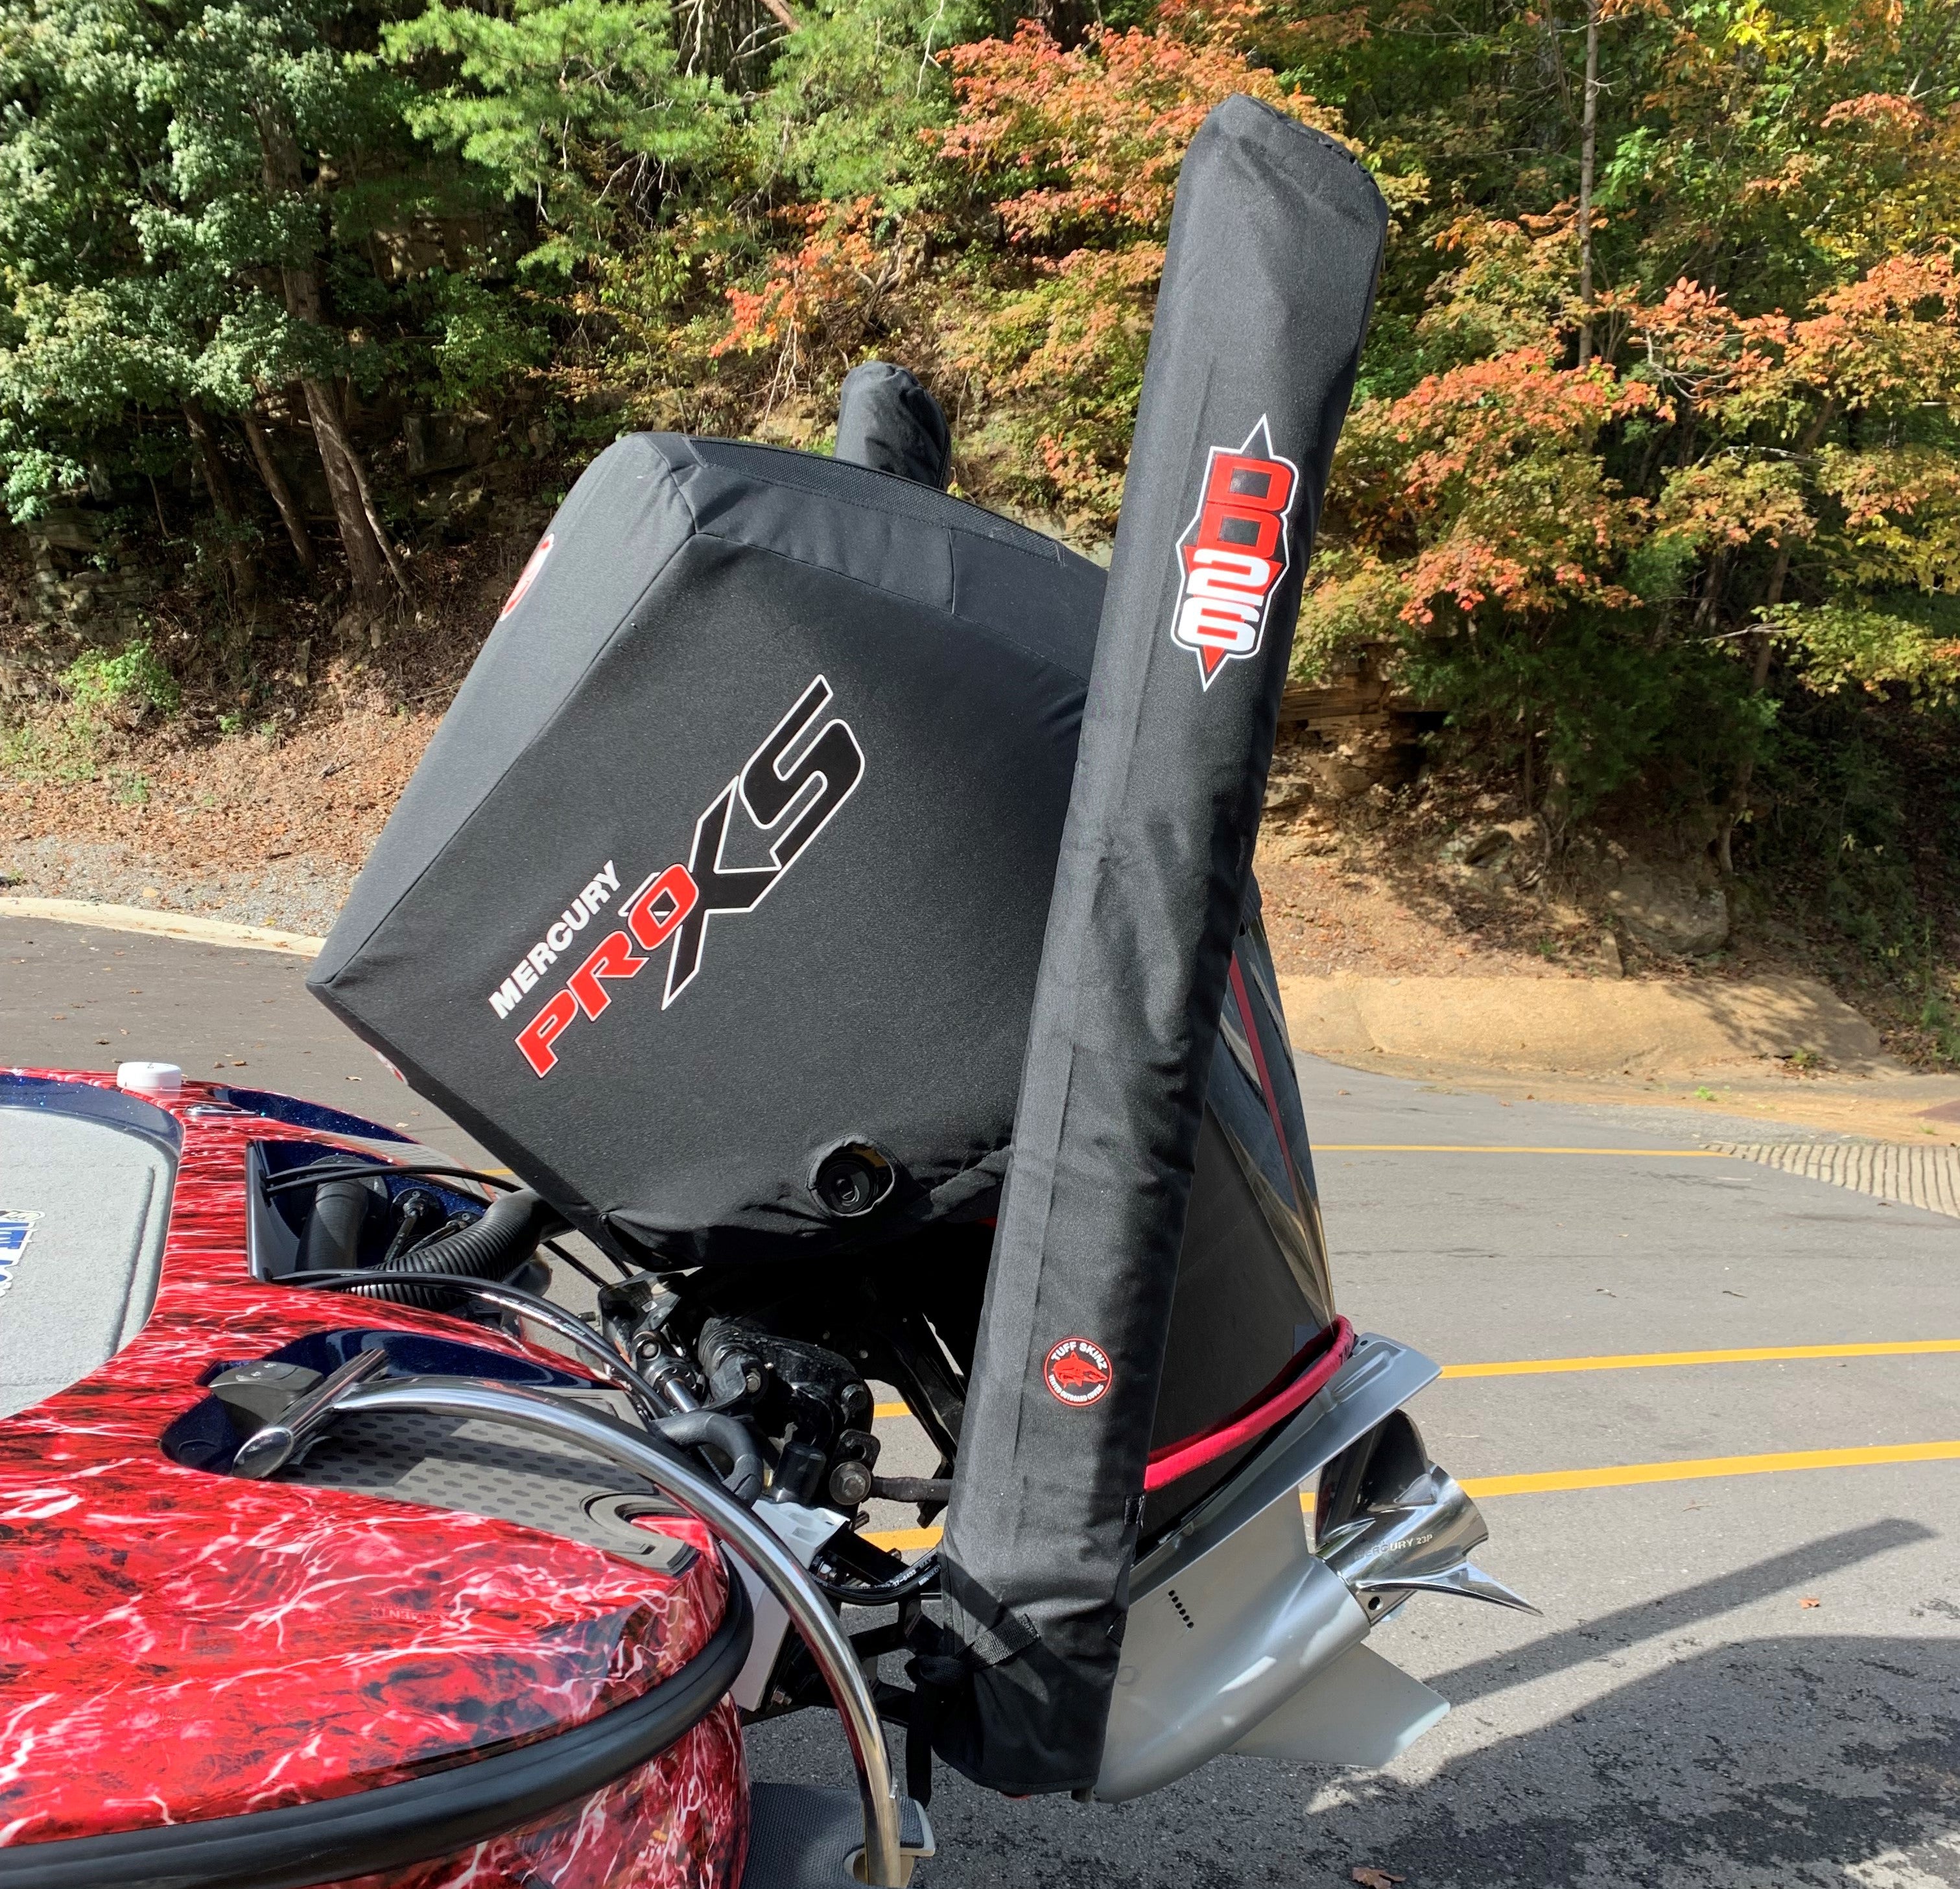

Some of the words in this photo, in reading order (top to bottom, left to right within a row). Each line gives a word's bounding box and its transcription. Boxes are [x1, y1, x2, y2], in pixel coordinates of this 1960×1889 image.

[515, 863, 699, 1078] PRO
[619, 674, 866, 1011] XS
[488, 860, 621, 1019] MERCURY
[1050, 1341, 1076, 1361] TUFF
[1079, 1342, 1107, 1370] SKINZ
[1416, 1534, 1433, 1545] 23P
